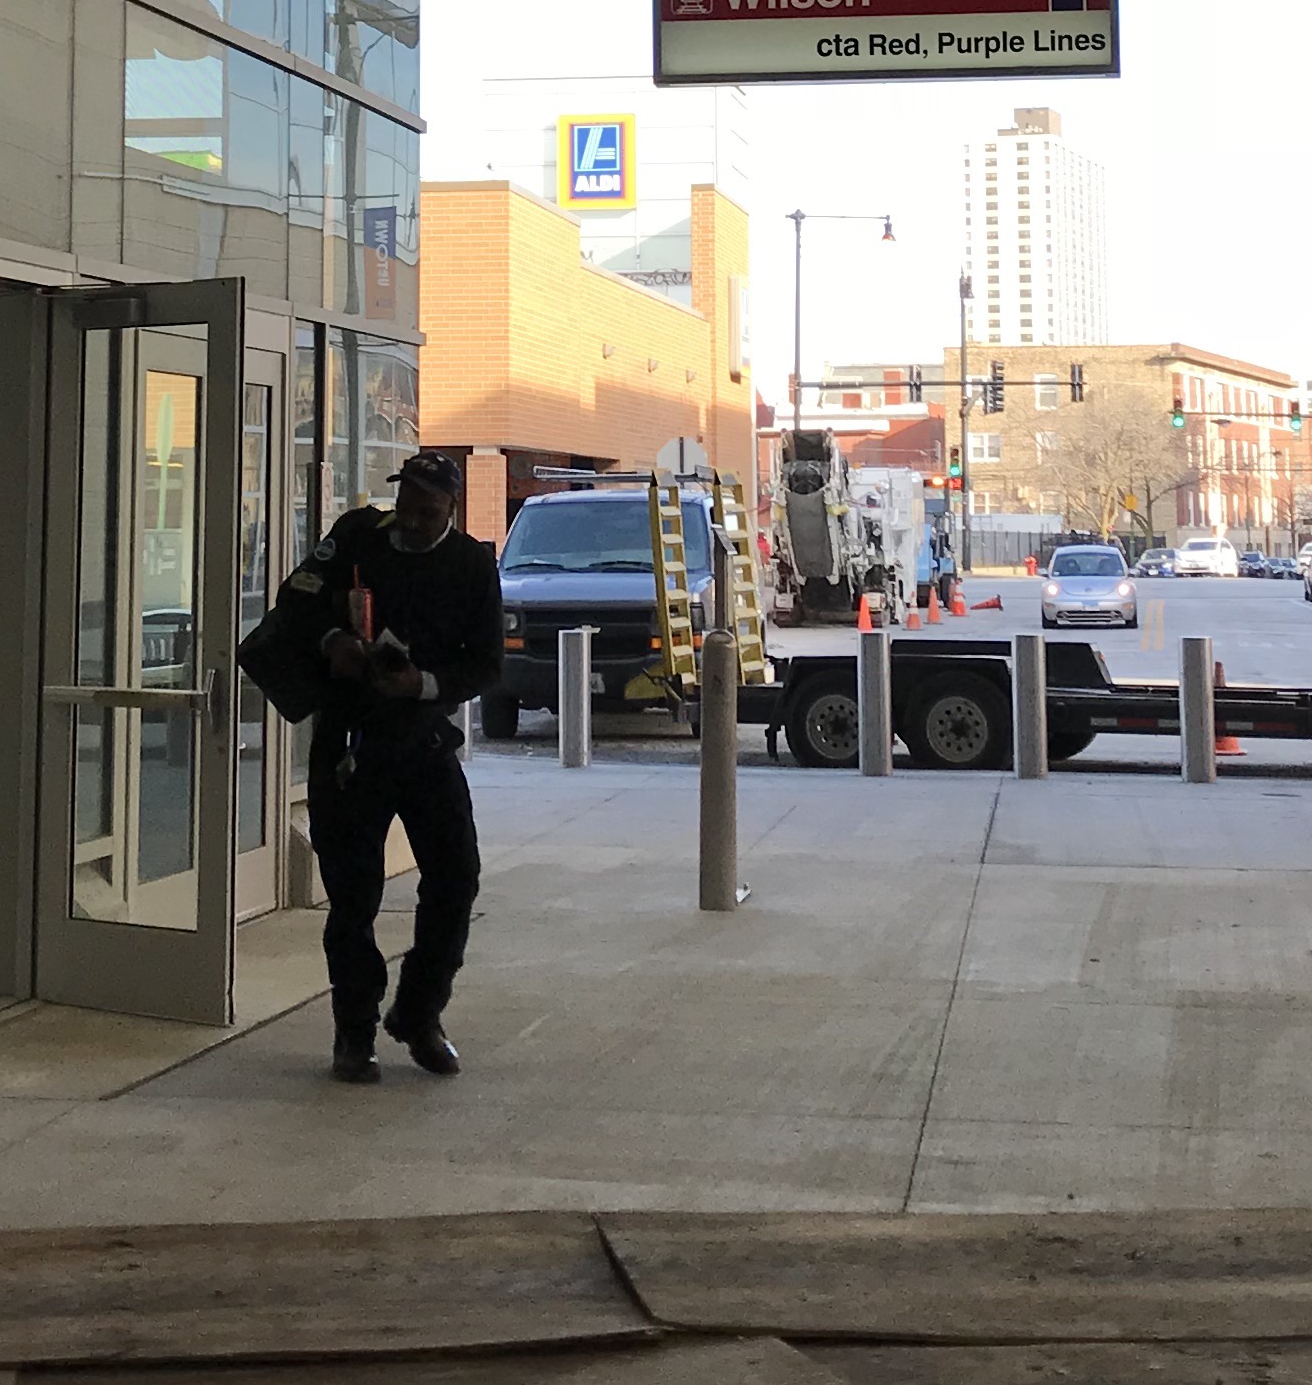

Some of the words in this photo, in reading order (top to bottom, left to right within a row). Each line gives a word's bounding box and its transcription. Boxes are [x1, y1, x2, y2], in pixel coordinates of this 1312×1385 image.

[816, 33, 860, 57] cta
[869, 33, 928, 59] Red,
[938, 31, 1025, 59] Purple
[1034, 29, 1107, 52] Lines
[574, 174, 621, 192] ALDI
